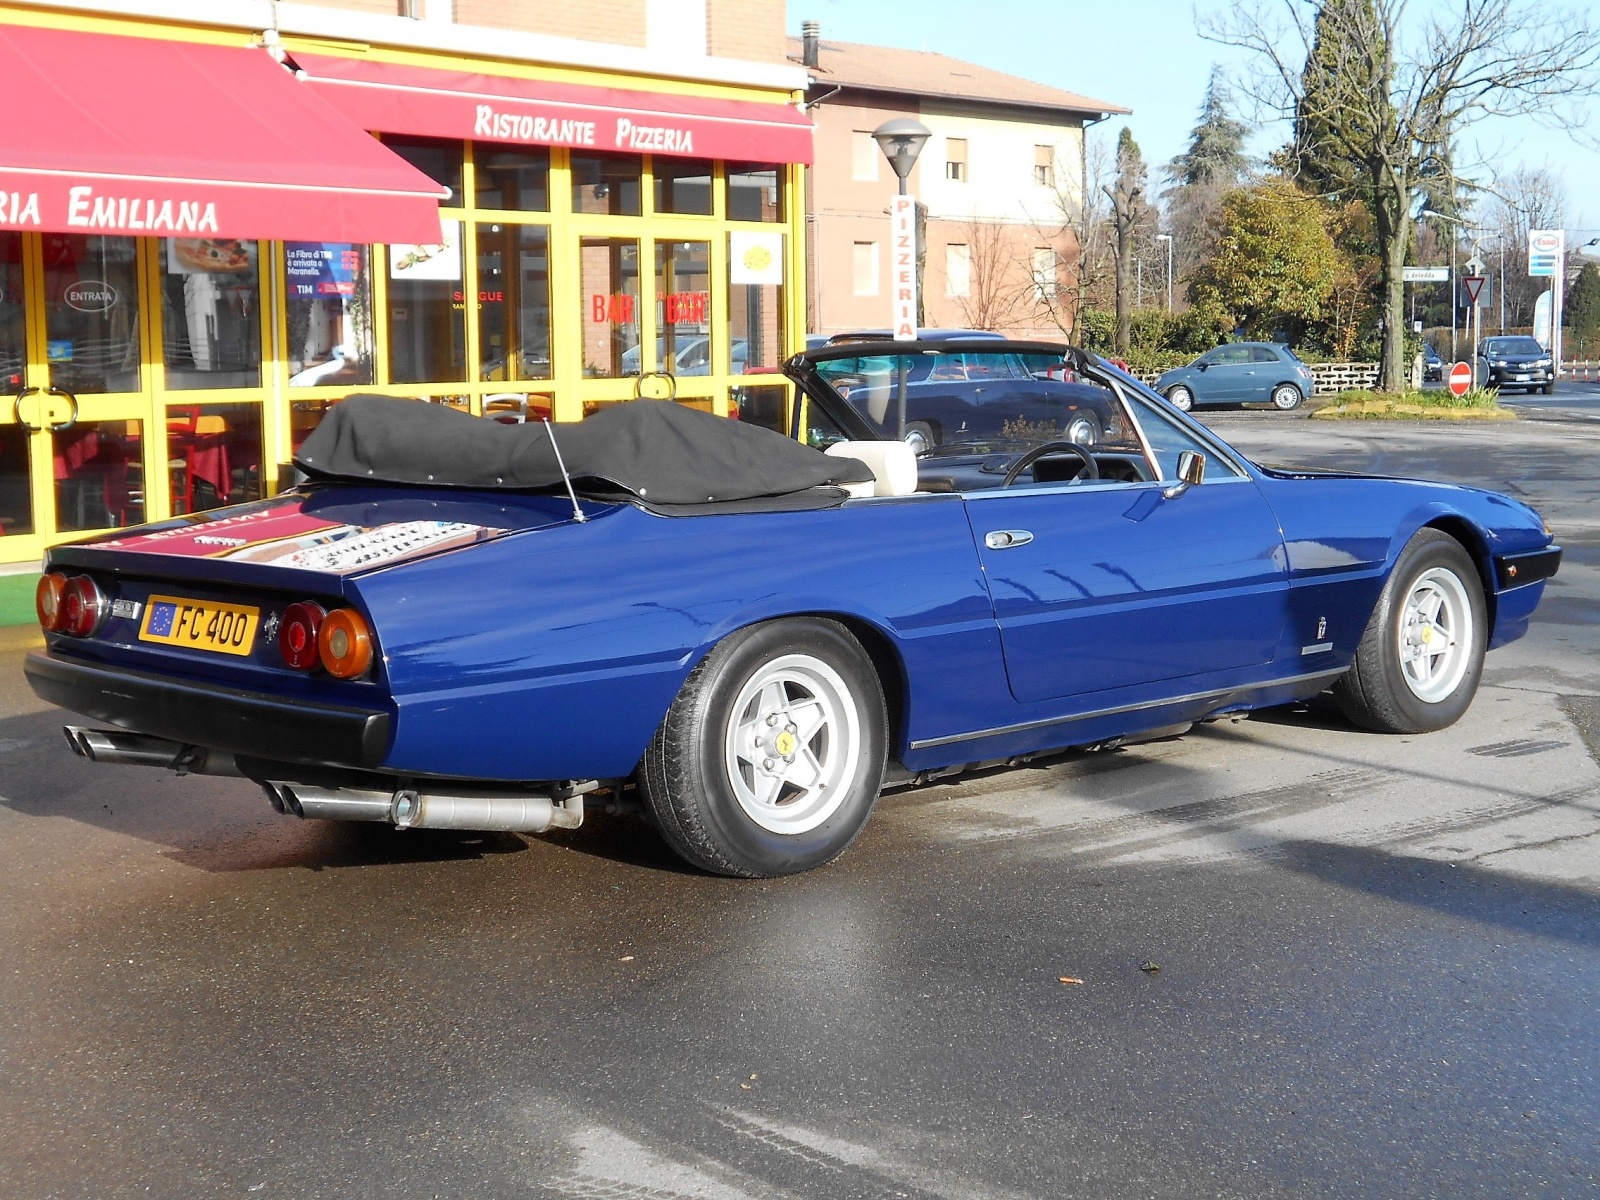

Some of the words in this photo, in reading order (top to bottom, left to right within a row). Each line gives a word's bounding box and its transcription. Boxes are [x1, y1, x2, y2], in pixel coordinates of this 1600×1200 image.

[474, 104, 595, 145] RISTORANTE
[615, 117, 693, 153] PIZZERIA
[67, 186, 219, 232] EMILIANA
[296, 249, 313, 258] Fibra
[313, 249, 320, 258] di
[897, 200, 913, 336] PIZZERIA
[70, 291, 112, 301] ENTRATA
[297, 285, 313, 294] TIM
[592, 293, 634, 323] BAR
[666, 293, 706, 323] BAR
[176, 605, 205, 640] FC
[206, 609, 248, 646] 400
